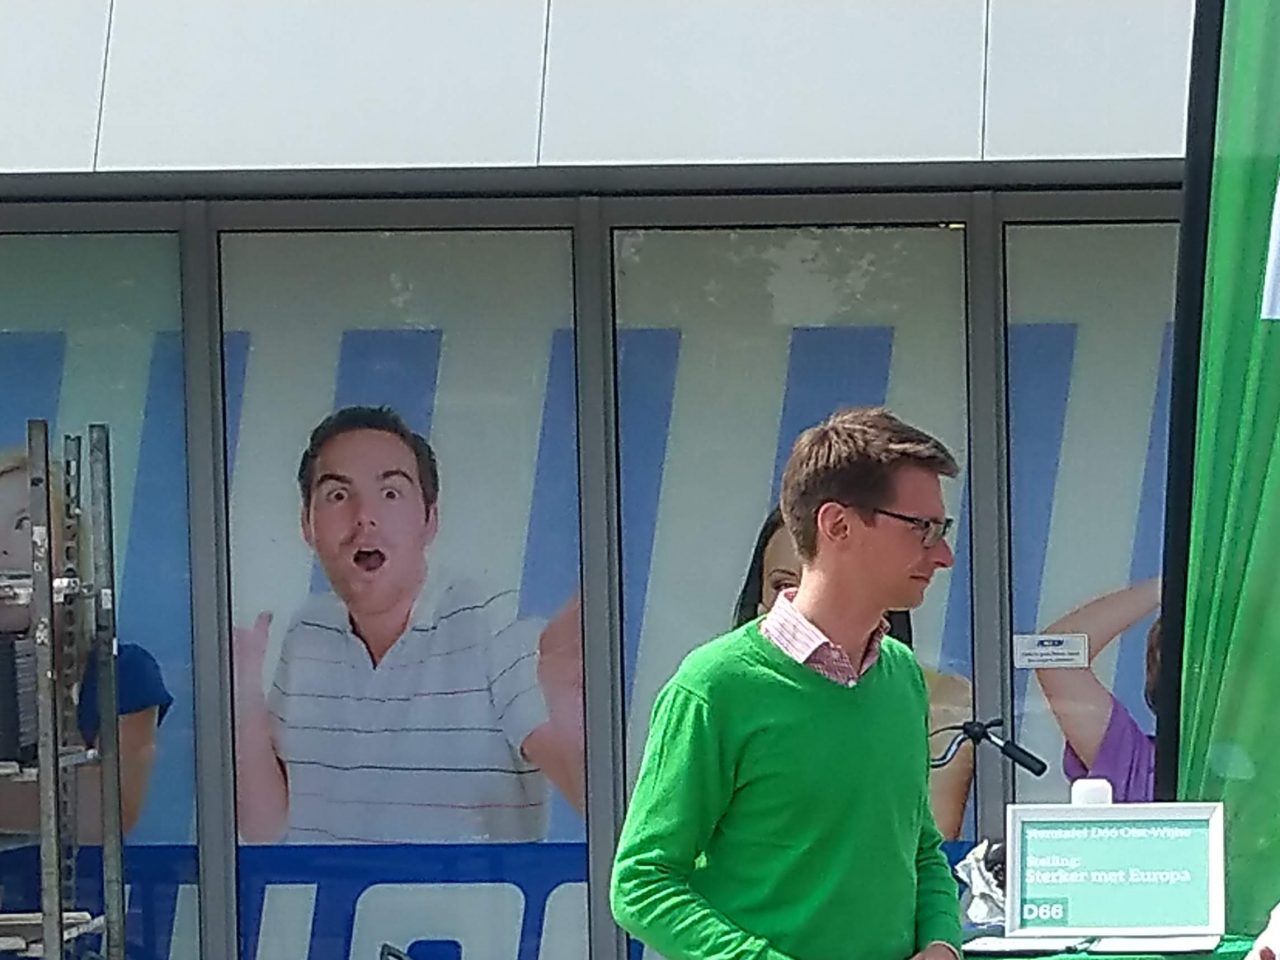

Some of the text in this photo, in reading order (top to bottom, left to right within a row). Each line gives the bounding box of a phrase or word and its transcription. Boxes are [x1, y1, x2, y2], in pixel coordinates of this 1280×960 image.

[1026, 868, 1192, 885] Sterker met Europa
[1023, 903, 1064, 920] D66
